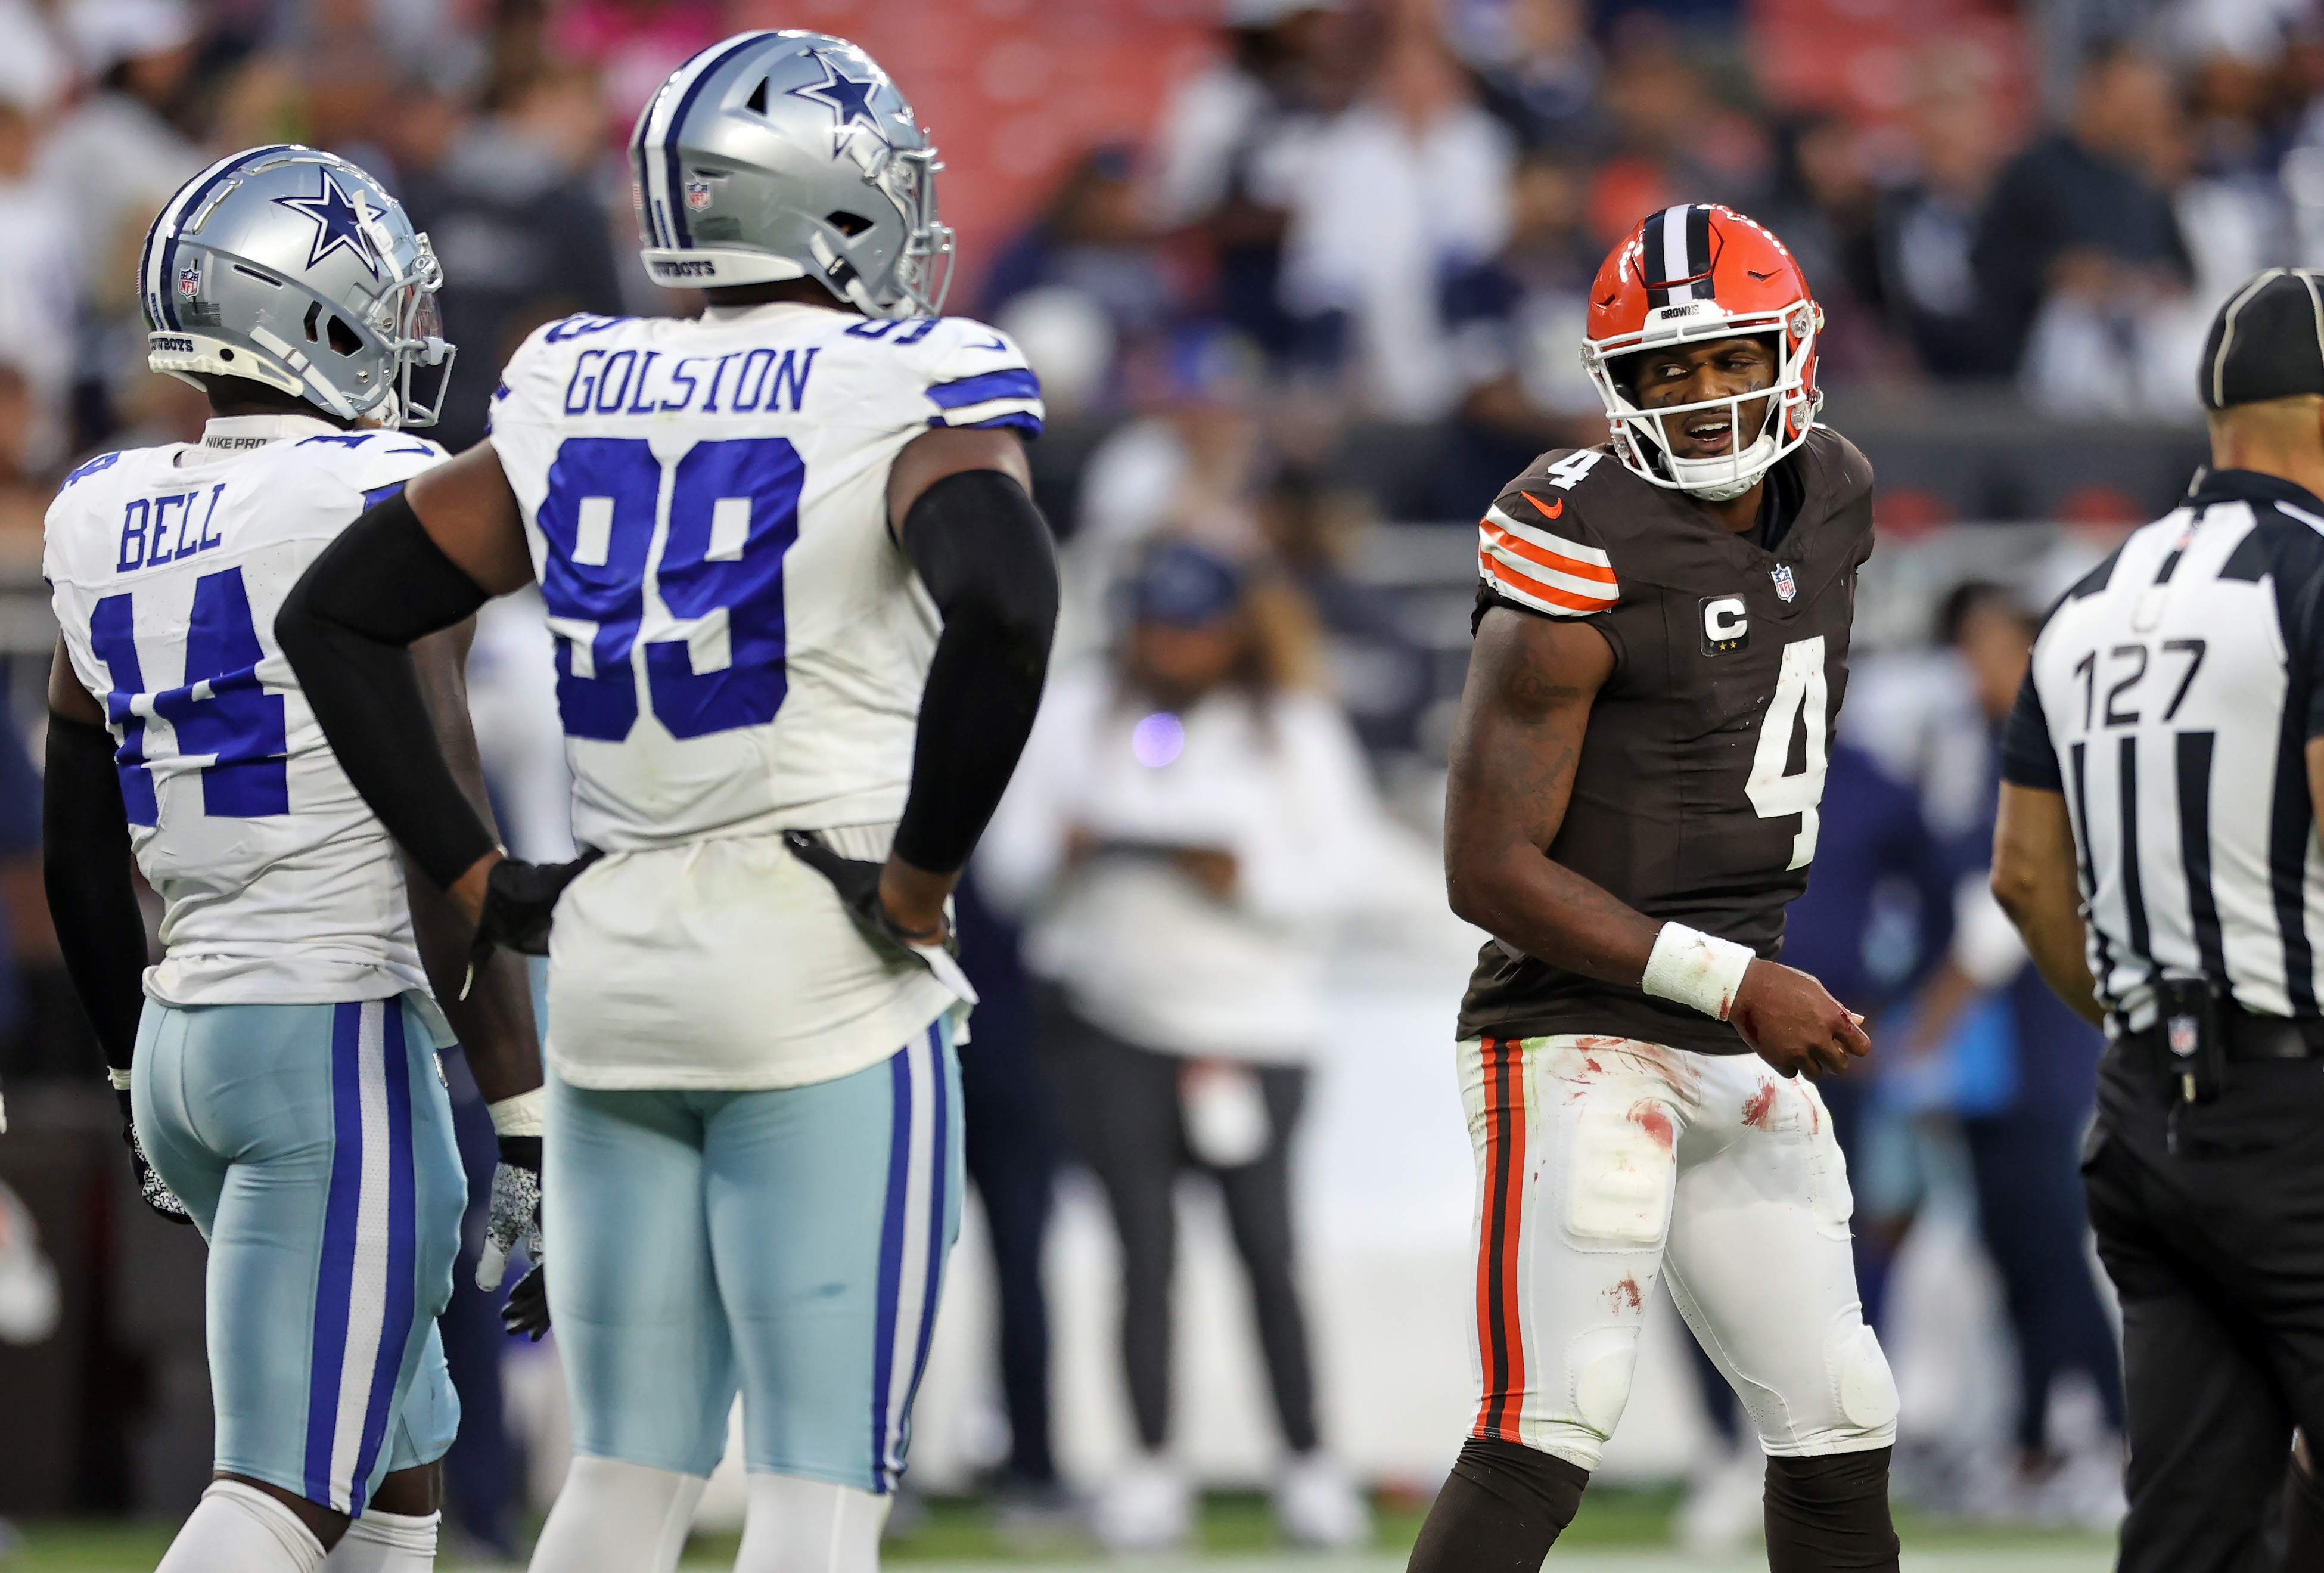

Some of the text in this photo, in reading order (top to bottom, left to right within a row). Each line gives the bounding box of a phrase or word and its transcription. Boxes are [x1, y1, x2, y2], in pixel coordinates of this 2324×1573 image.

[181, 280, 196, 294] NFL
[1661, 305, 1699, 320] BROWNS
[564, 348, 822, 415] GOLSTON
[205, 437, 232, 449] NIKE
[1548, 449, 1604, 491] 4
[116, 483, 226, 573] BELL
[536, 436, 806, 744] 99
[1778, 581, 1794, 595] NFL
[1704, 598, 1748, 641] C
[90, 565, 290, 827] 14
[2073, 638, 2207, 733] 127
[1744, 635, 1828, 871] 4
